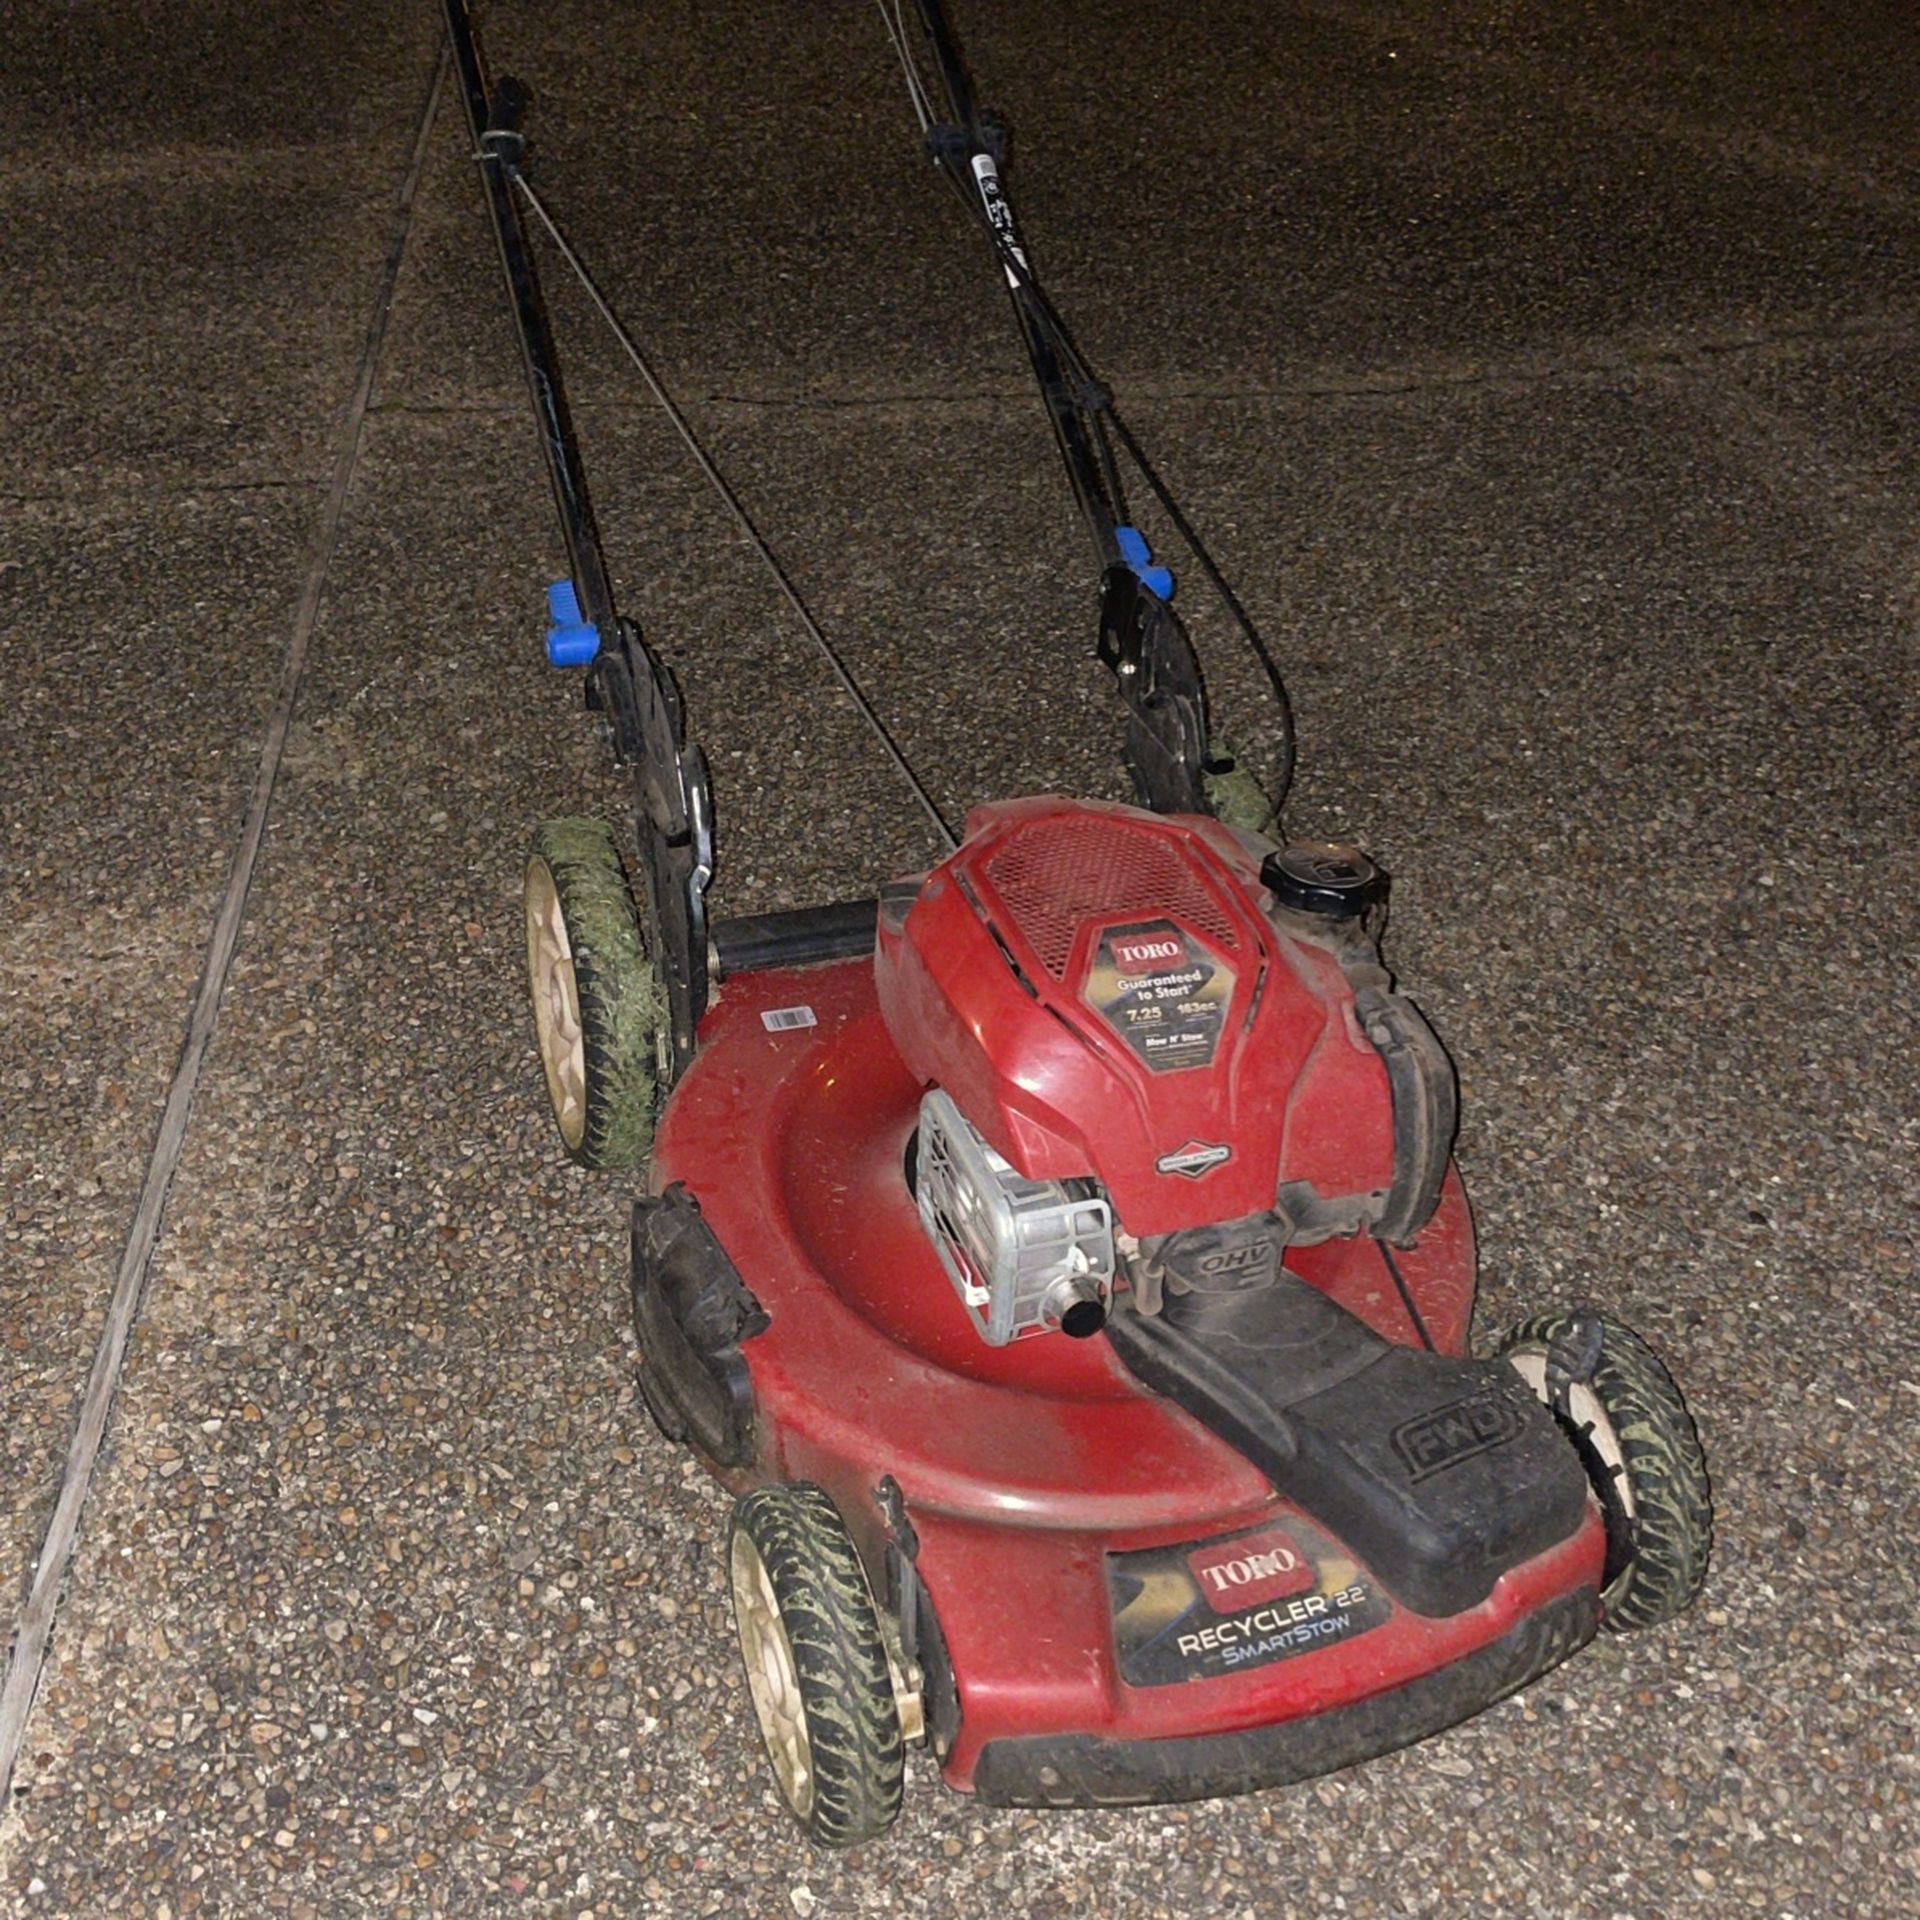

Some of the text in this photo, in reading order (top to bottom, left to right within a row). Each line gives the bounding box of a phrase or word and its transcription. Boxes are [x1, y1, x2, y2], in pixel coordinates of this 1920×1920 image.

[1117, 941, 1179, 962] TORO
[1117, 969, 1202, 991] Guaranteed
[1138, 988, 1153, 1000] to
[1126, 1006, 1162, 1021] 7.25
[1202, 1246, 1270, 1272] OHV
[1411, 1403, 1501, 1463] FWD
[1202, 1548, 1296, 1591] TORO
[1177, 1596, 1328, 1656] RECYCLER
